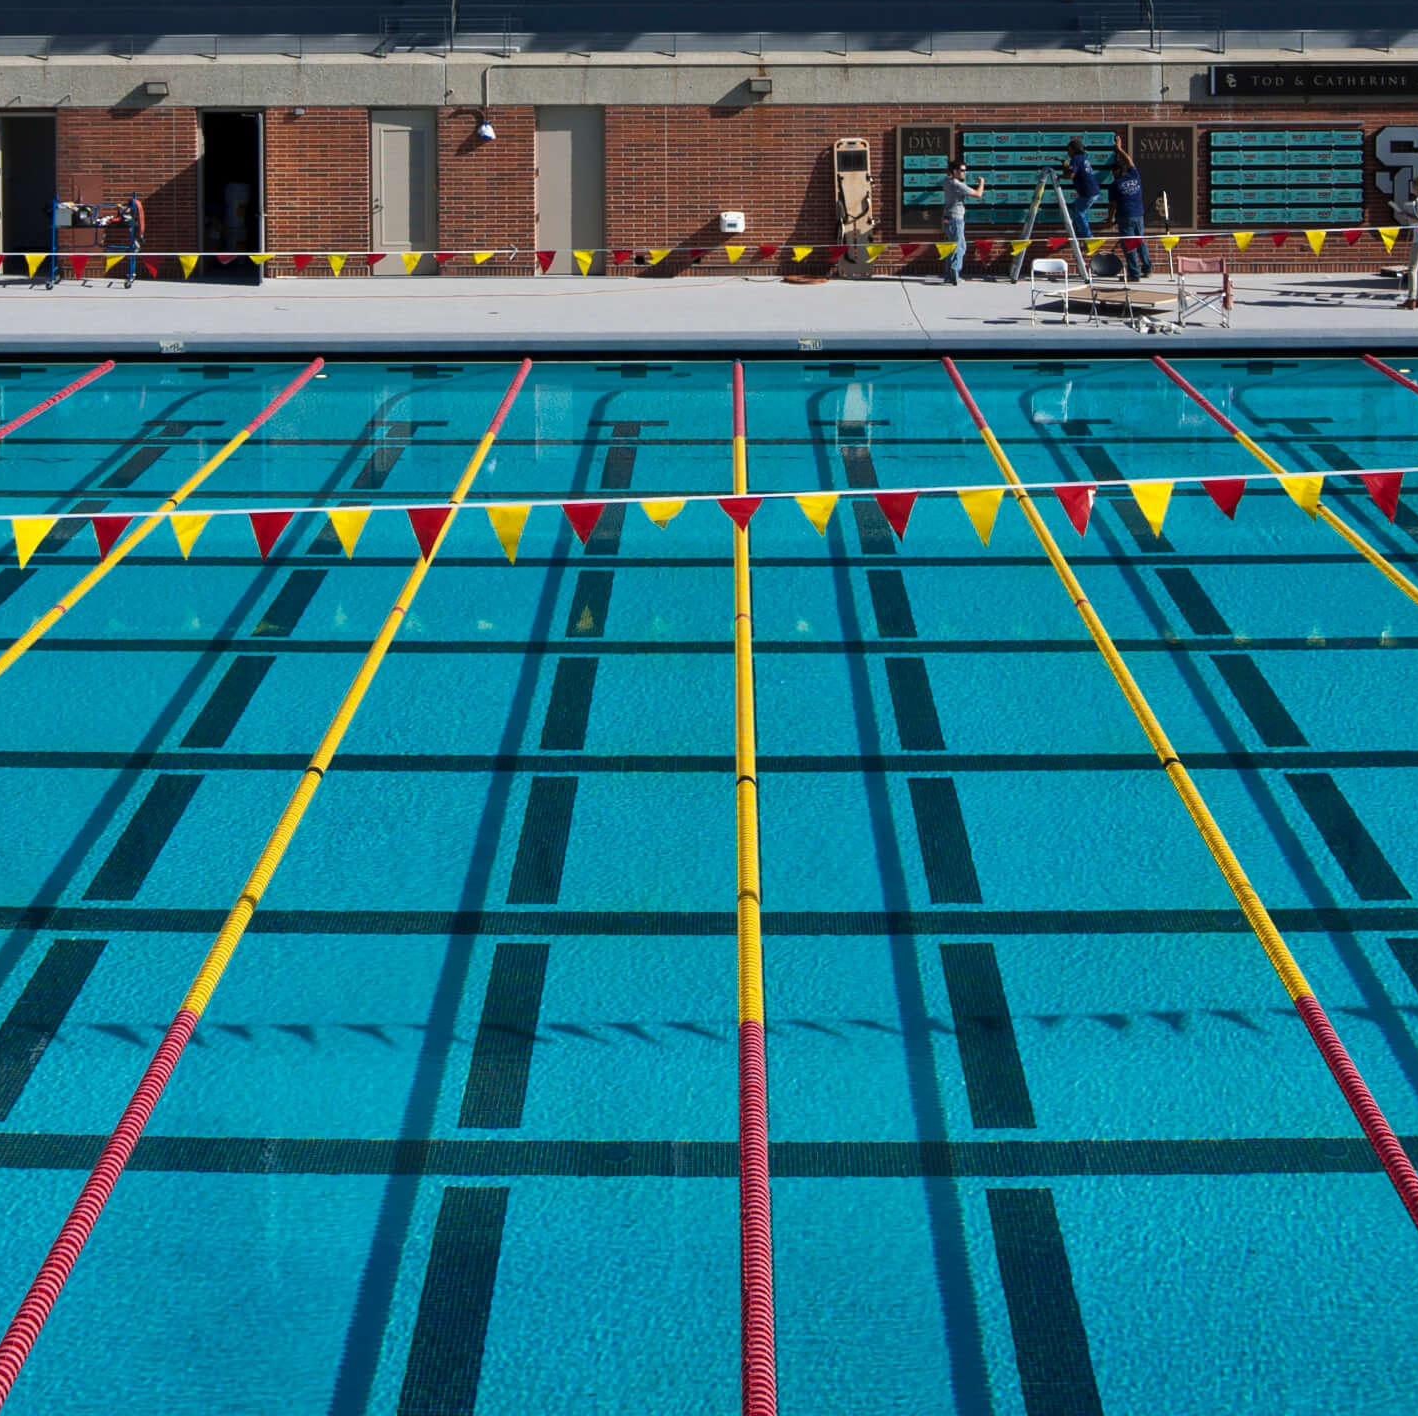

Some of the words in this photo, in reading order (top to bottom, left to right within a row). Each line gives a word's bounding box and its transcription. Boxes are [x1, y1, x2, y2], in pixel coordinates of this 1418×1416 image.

[1251, 74, 1285, 88] TOD
[1313, 74, 1407, 88] CATHERINE
[1140, 137, 1185, 152] SWIM
